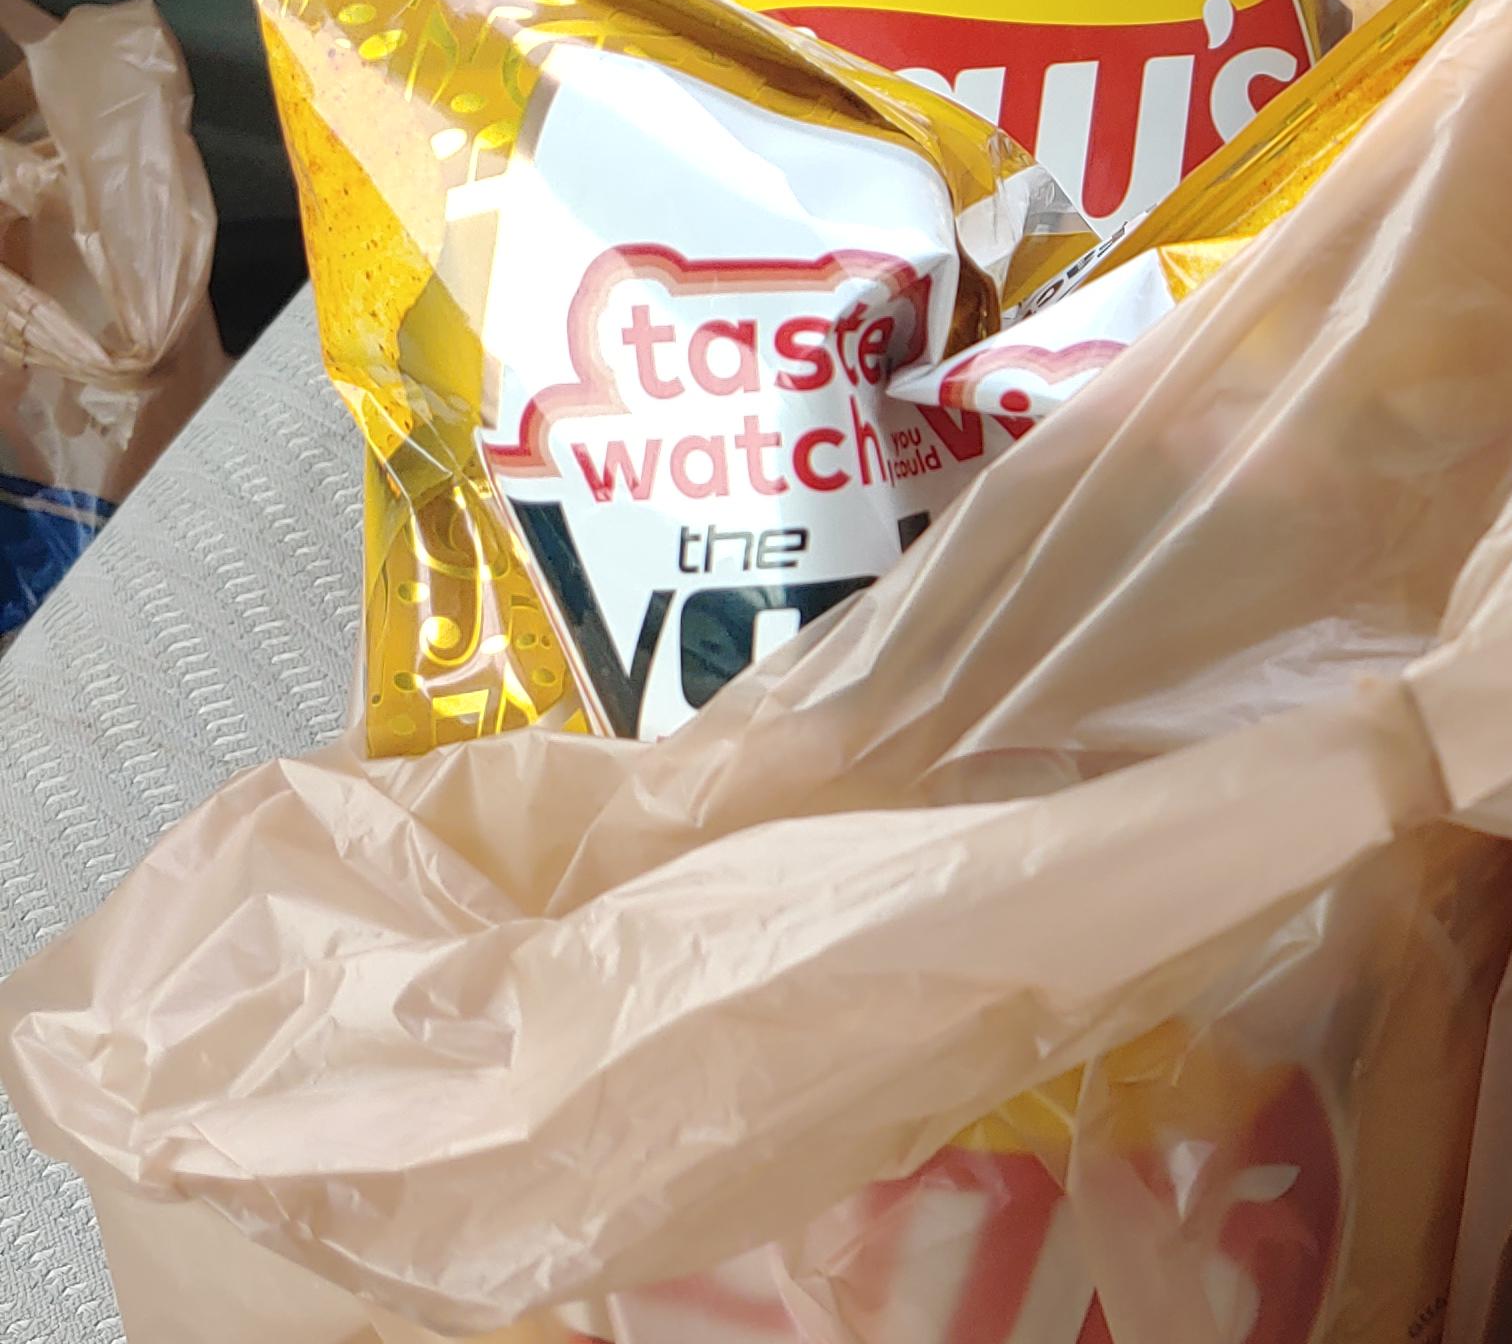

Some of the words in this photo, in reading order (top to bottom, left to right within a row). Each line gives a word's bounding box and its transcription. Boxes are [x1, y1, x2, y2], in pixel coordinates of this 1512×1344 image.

[571, 393, 888, 503] watch
[890, 425, 922, 453] you
[676, 523, 809, 574] the
